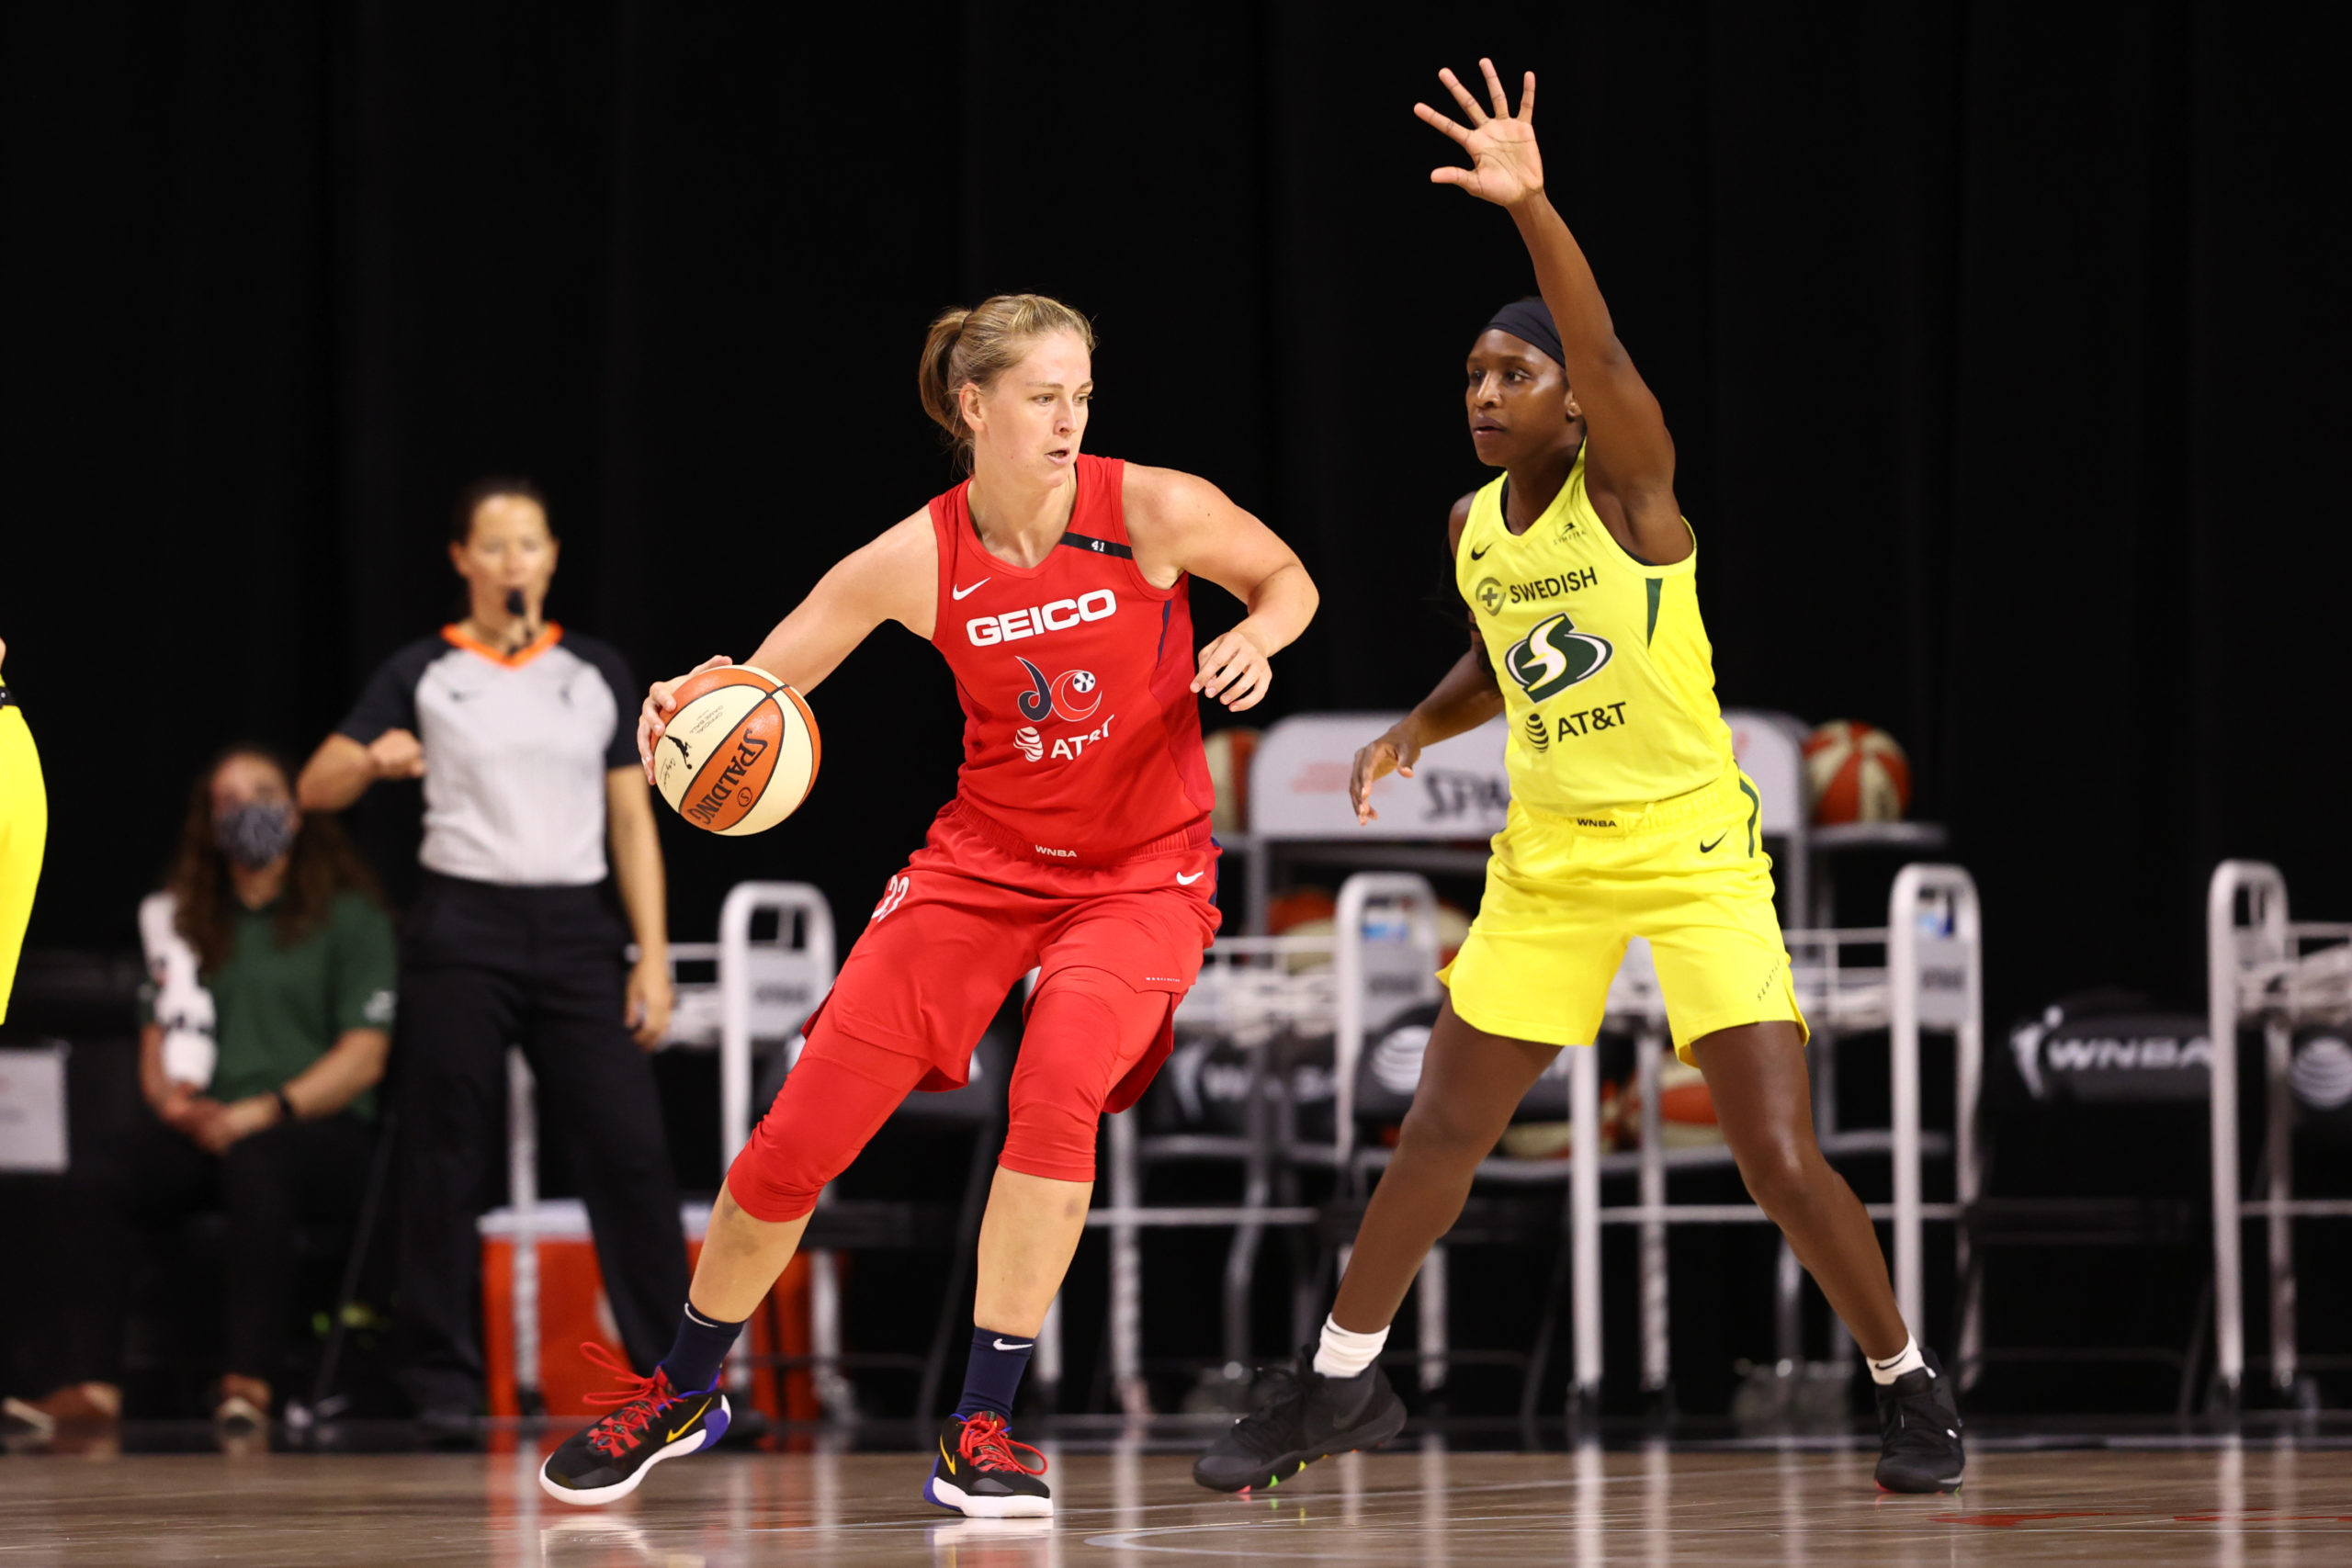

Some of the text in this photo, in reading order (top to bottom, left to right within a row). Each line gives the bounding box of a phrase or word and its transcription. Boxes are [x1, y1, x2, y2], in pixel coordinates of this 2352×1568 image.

[1091, 540, 1105, 552] 41
[1510, 567, 1599, 604] SWEDISH
[966, 588, 1117, 647] GEICO
[1050, 714, 1115, 761] AT&T
[1558, 702, 1626, 742] AT&T
[687, 728, 768, 825] SPALDING
[1577, 818, 1617, 828] WNBA
[1035, 844, 1078, 858] WNBA
[2048, 1039, 2212, 1069] WNBA
